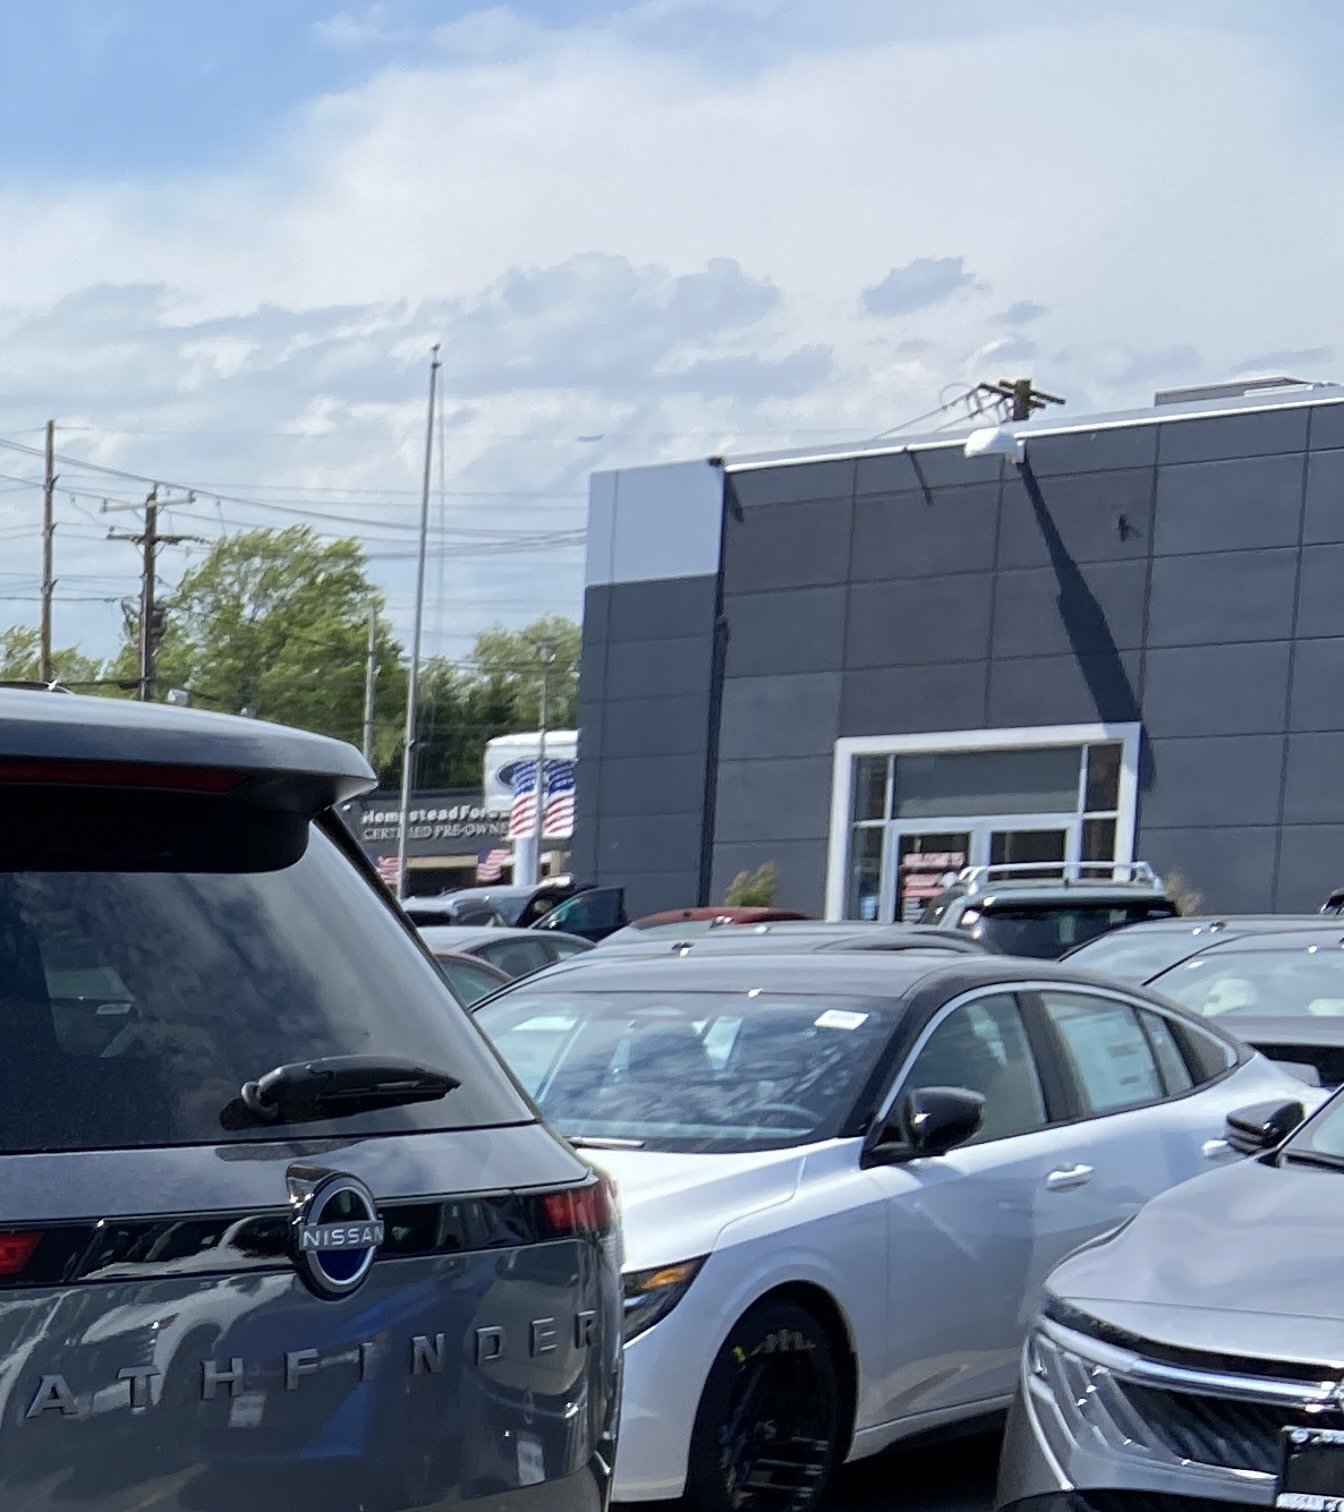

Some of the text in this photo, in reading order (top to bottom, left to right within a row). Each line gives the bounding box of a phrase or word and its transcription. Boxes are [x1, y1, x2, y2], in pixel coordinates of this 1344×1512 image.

[362, 806, 459, 824] Hemstead
[364, 822, 510, 841] CERTIIED PRE-OWNE
[303, 1225, 384, 1247] NISSAN
